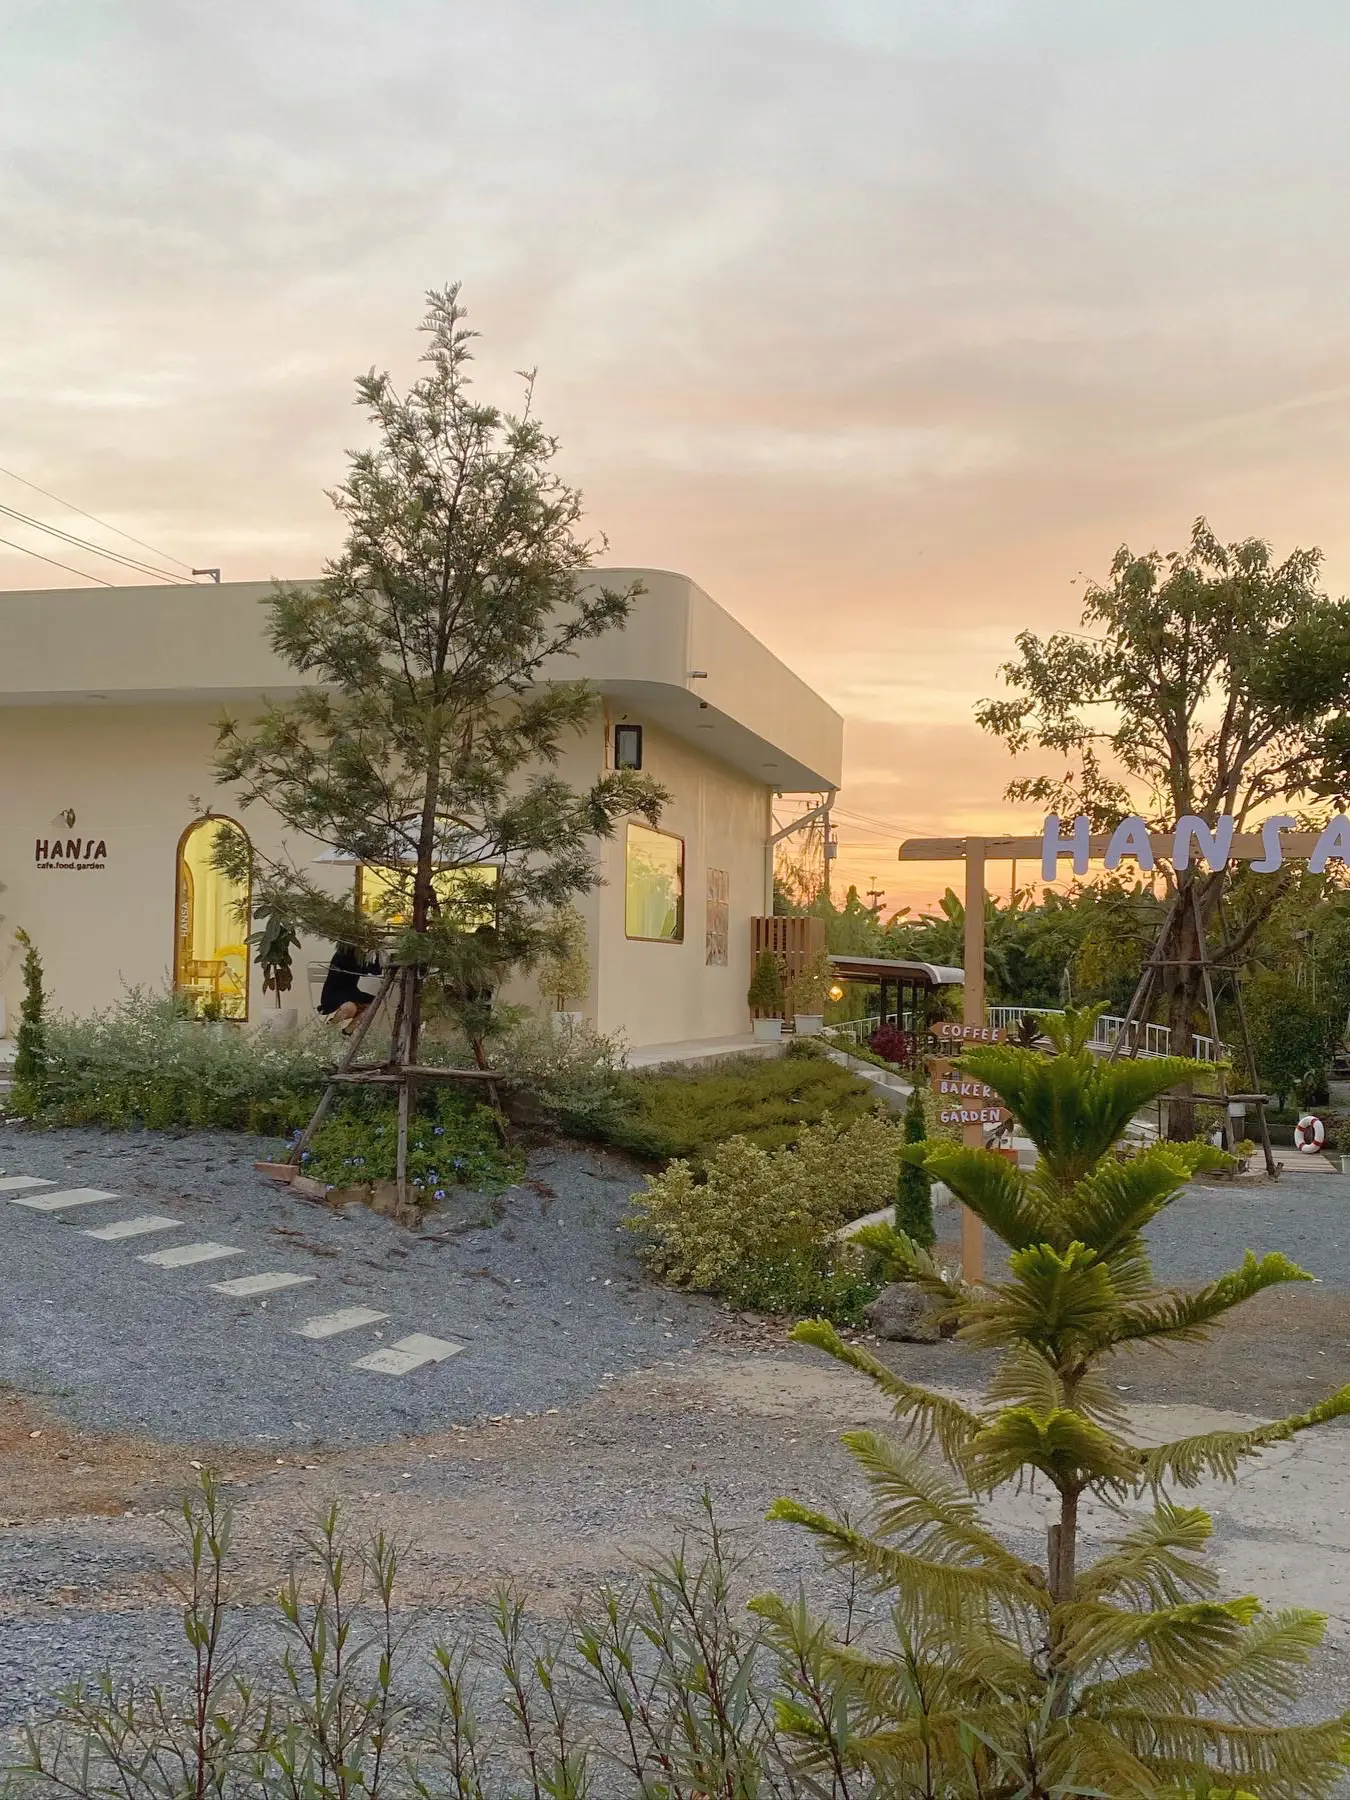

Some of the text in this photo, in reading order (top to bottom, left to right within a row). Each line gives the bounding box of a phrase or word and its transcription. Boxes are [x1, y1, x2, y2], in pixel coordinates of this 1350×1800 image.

[35, 838, 107, 861] HANSA
[1041, 814, 1350, 882] HANSA
[181, 902, 189, 937] HANSA
[942, 1025, 1000, 1041] COFFEE
[940, 1109, 1000, 1123] GARDEN
